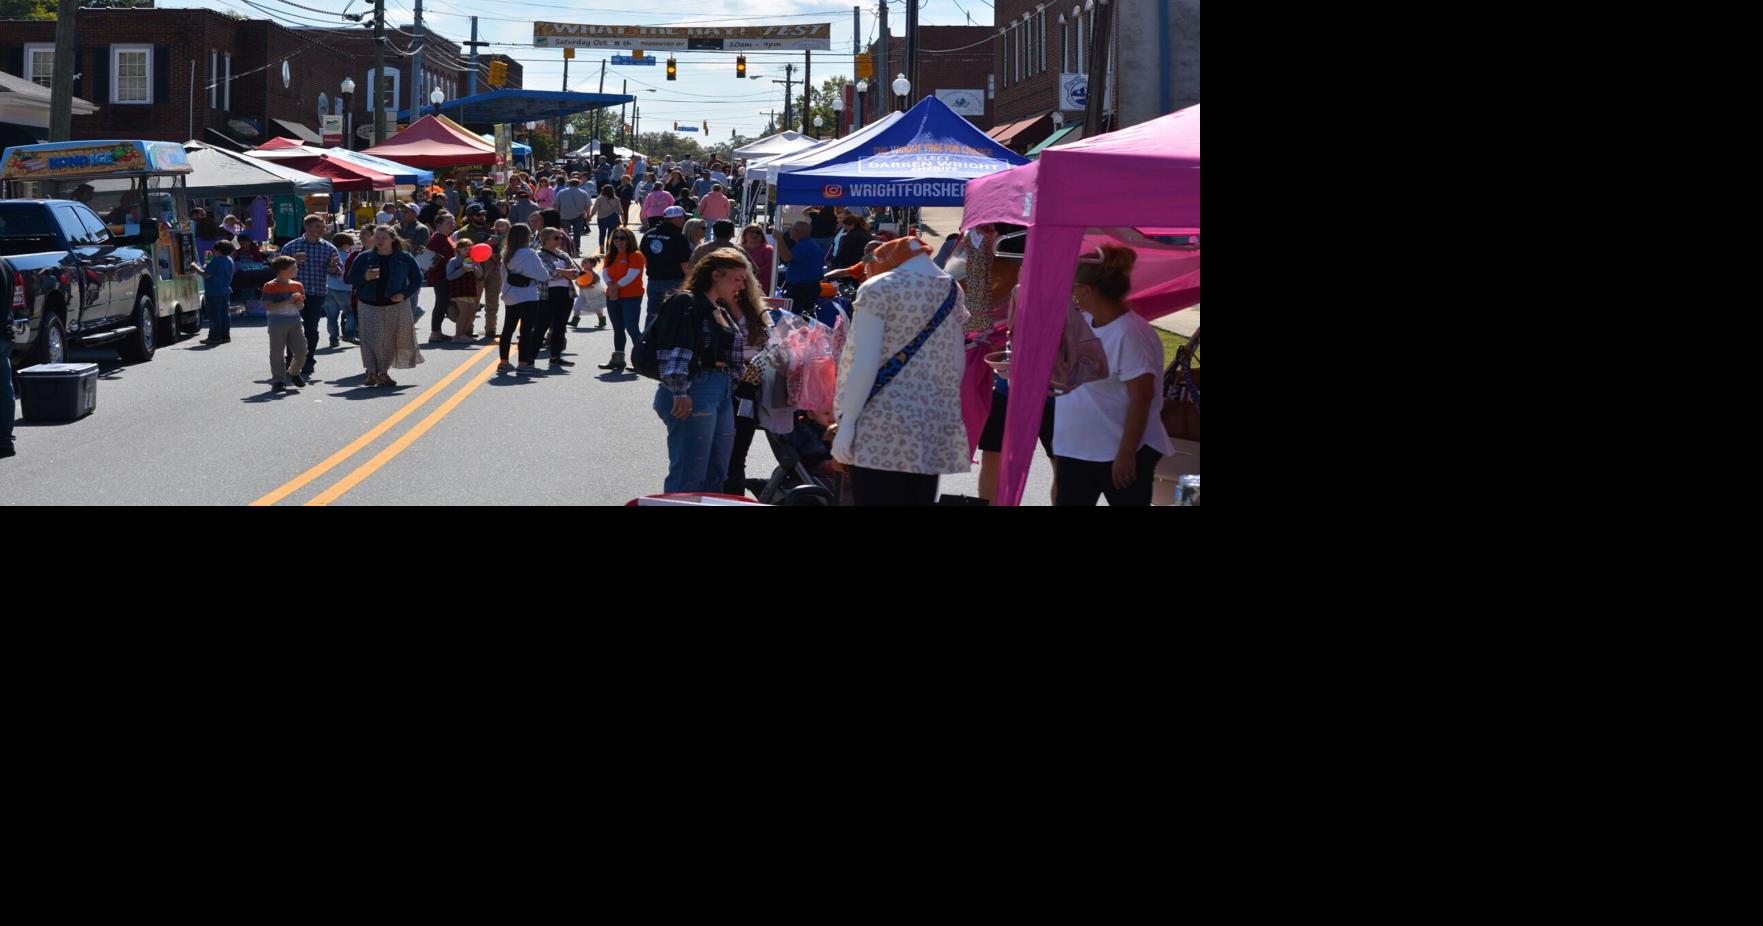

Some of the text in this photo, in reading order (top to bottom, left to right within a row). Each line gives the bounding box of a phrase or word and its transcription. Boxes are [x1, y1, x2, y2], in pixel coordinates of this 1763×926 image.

[552, 24, 625, 34] WHAT
[763, 24, 825, 36] FEST
[554, 38, 591, 47] Saturday
[90, 151, 112, 165] ICE
[868, 160, 1000, 170] DARREN WRIGHT
